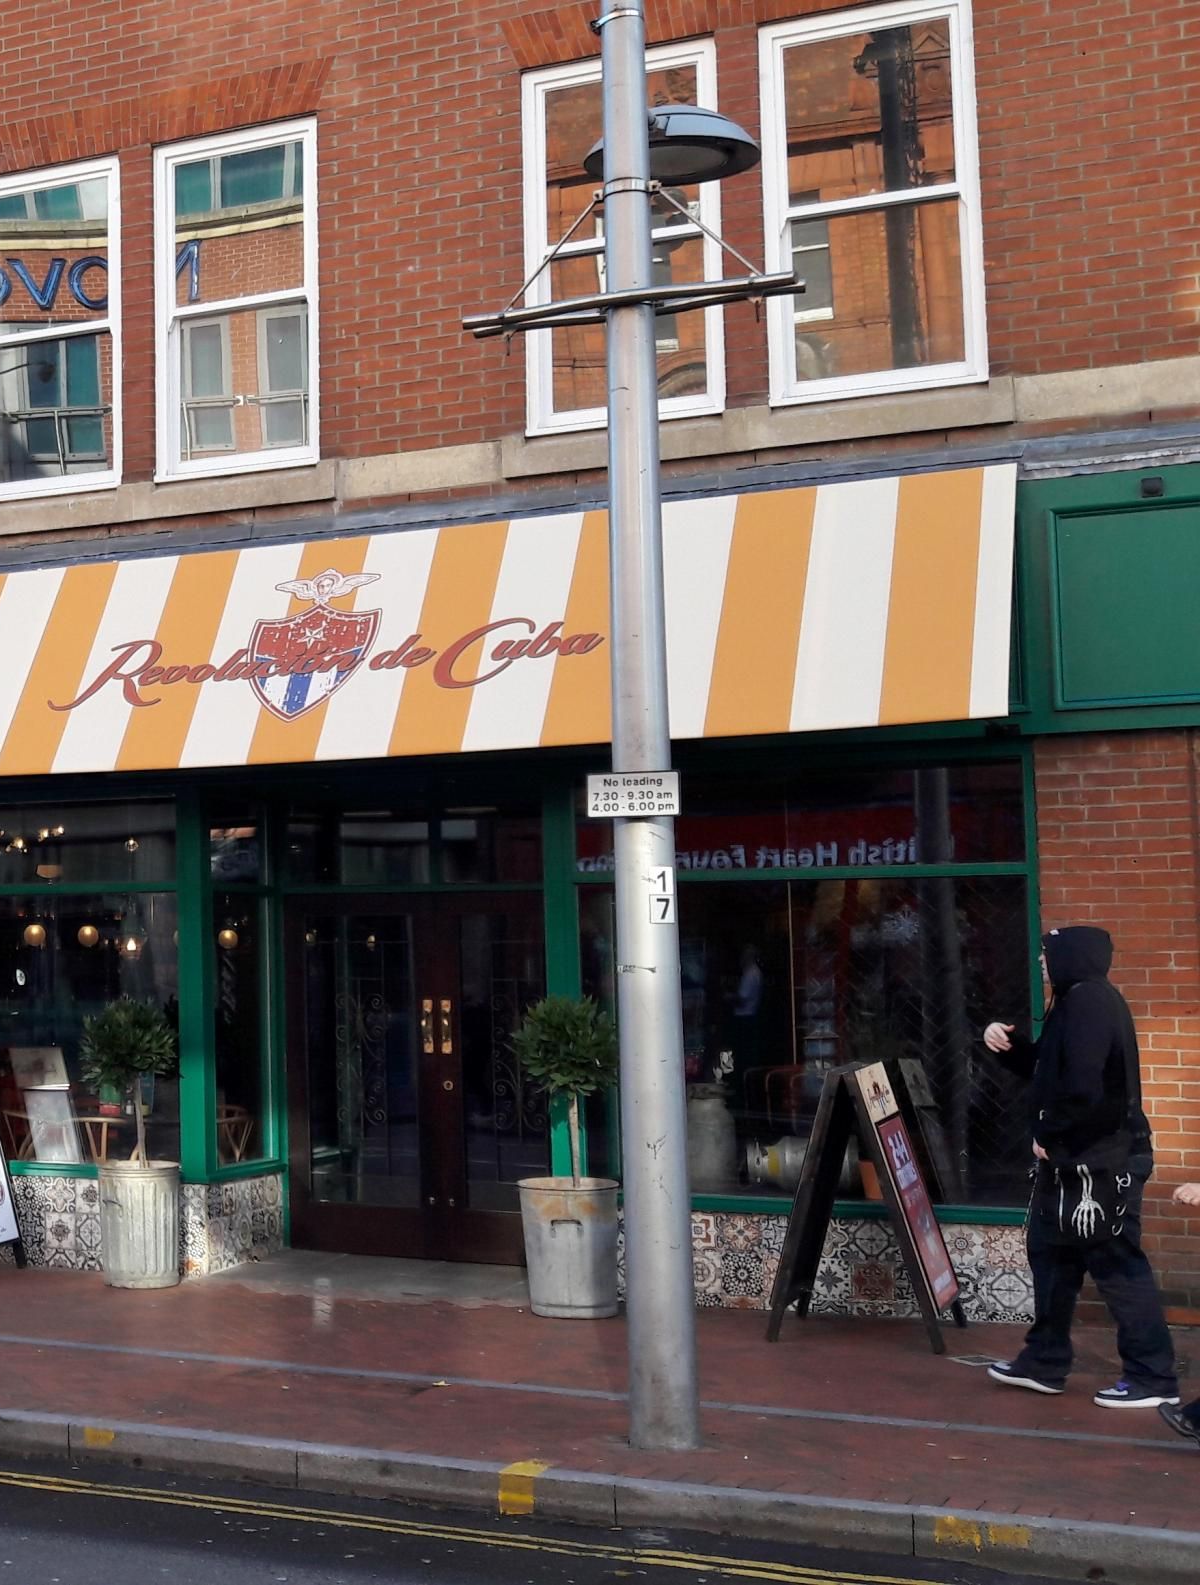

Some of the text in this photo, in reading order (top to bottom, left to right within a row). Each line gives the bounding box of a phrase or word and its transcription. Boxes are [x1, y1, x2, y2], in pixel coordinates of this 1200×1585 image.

[368, 633, 438, 671] de
[433, 617, 605, 689] Cuba
[603, 777, 663, 787] No loading
[593, 792, 618, 801] 7.30
[627, 790, 653, 800] 9.30
[656, 791, 673, 799] am
[592, 803, 619, 812] 4.00
[628, 802, 655, 811] 6.00
[657, 803, 675, 812] pm
[657, 870, 667, 892] 1
[656, 898, 670, 920] 7
